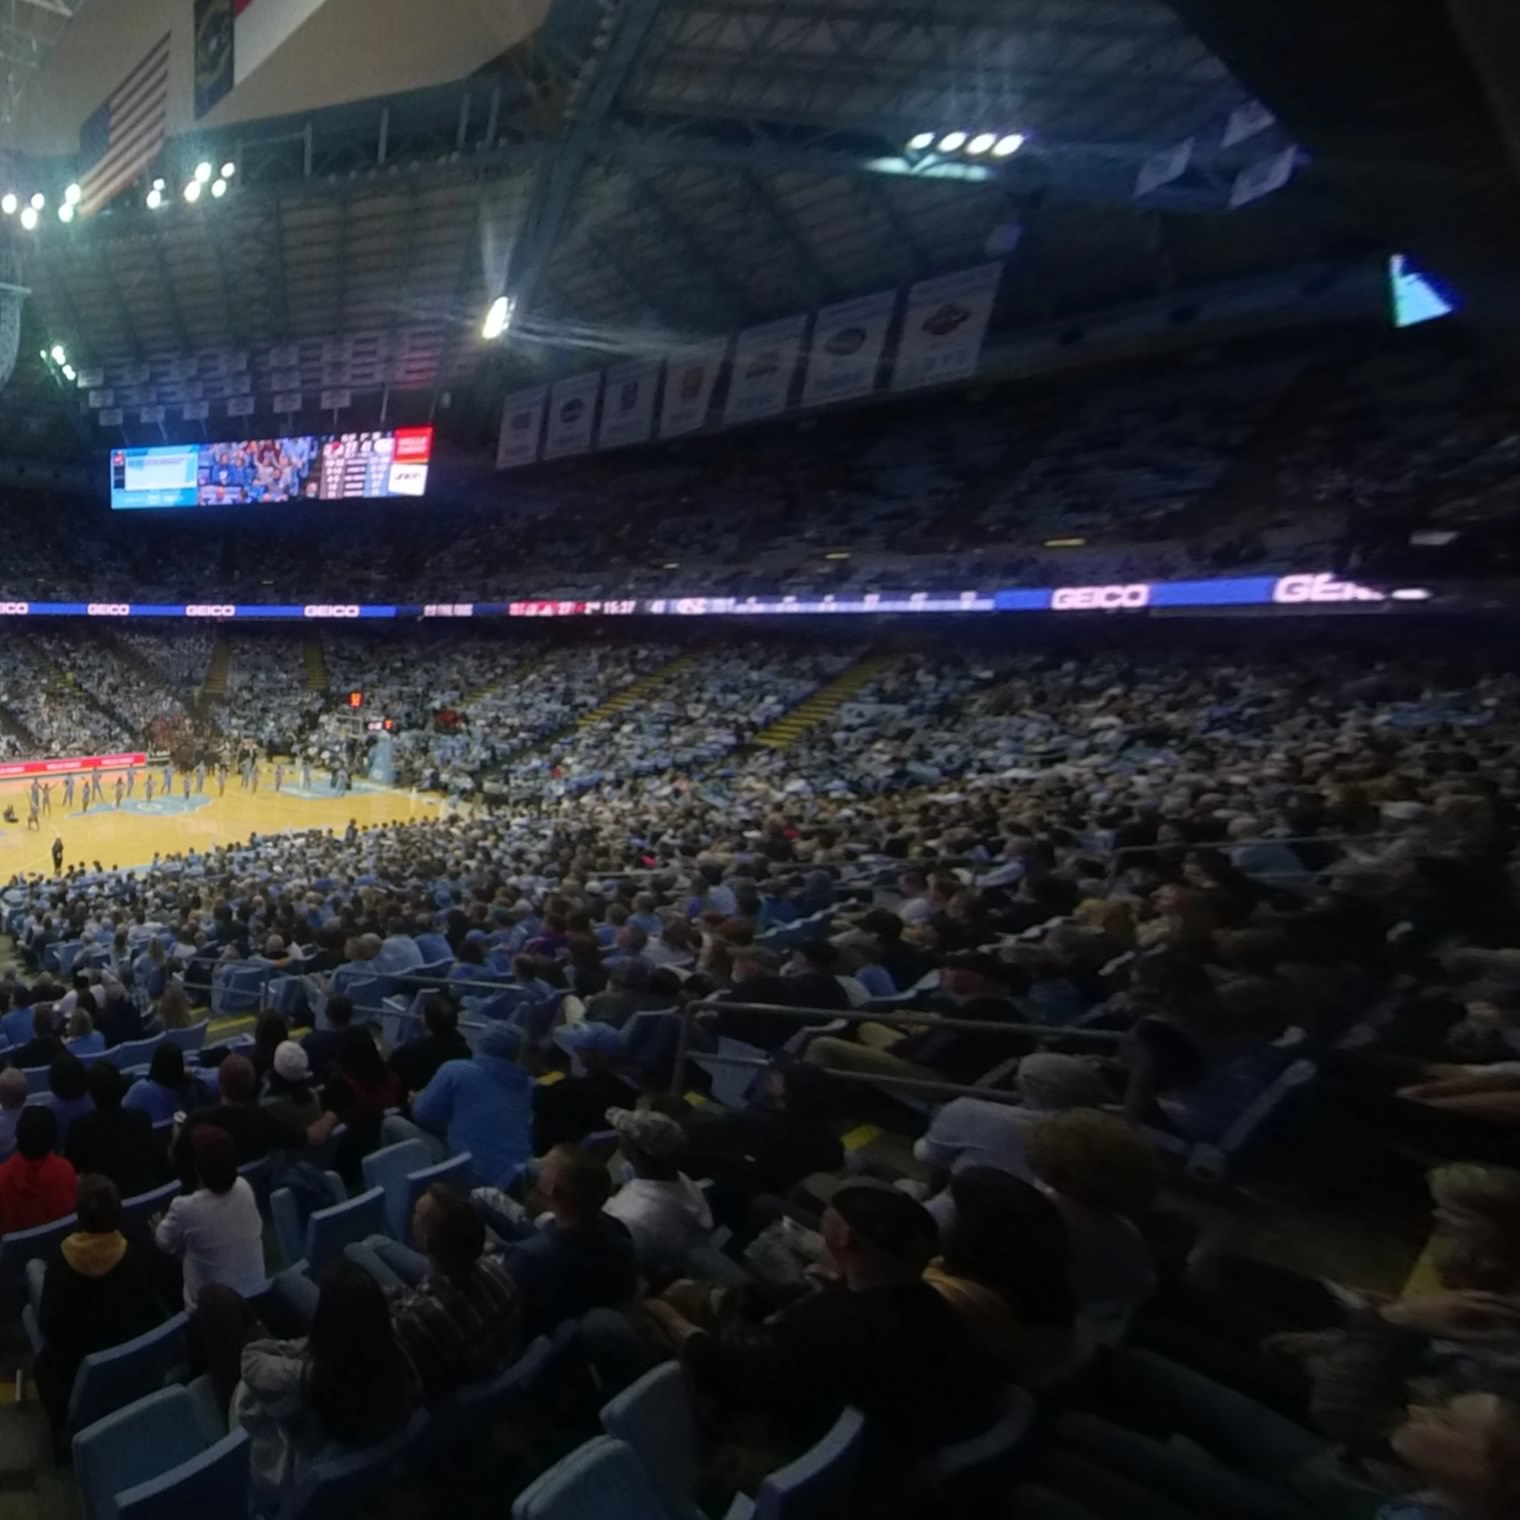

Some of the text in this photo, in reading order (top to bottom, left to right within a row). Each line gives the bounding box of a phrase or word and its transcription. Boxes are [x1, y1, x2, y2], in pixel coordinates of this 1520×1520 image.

[1051, 584, 1150, 611] GEICO
[88, 603, 130, 616] GEICO
[185, 604, 235, 617] GEICO
[304, 605, 359, 618] GEICO
[603, 600, 635, 614] 15:37
